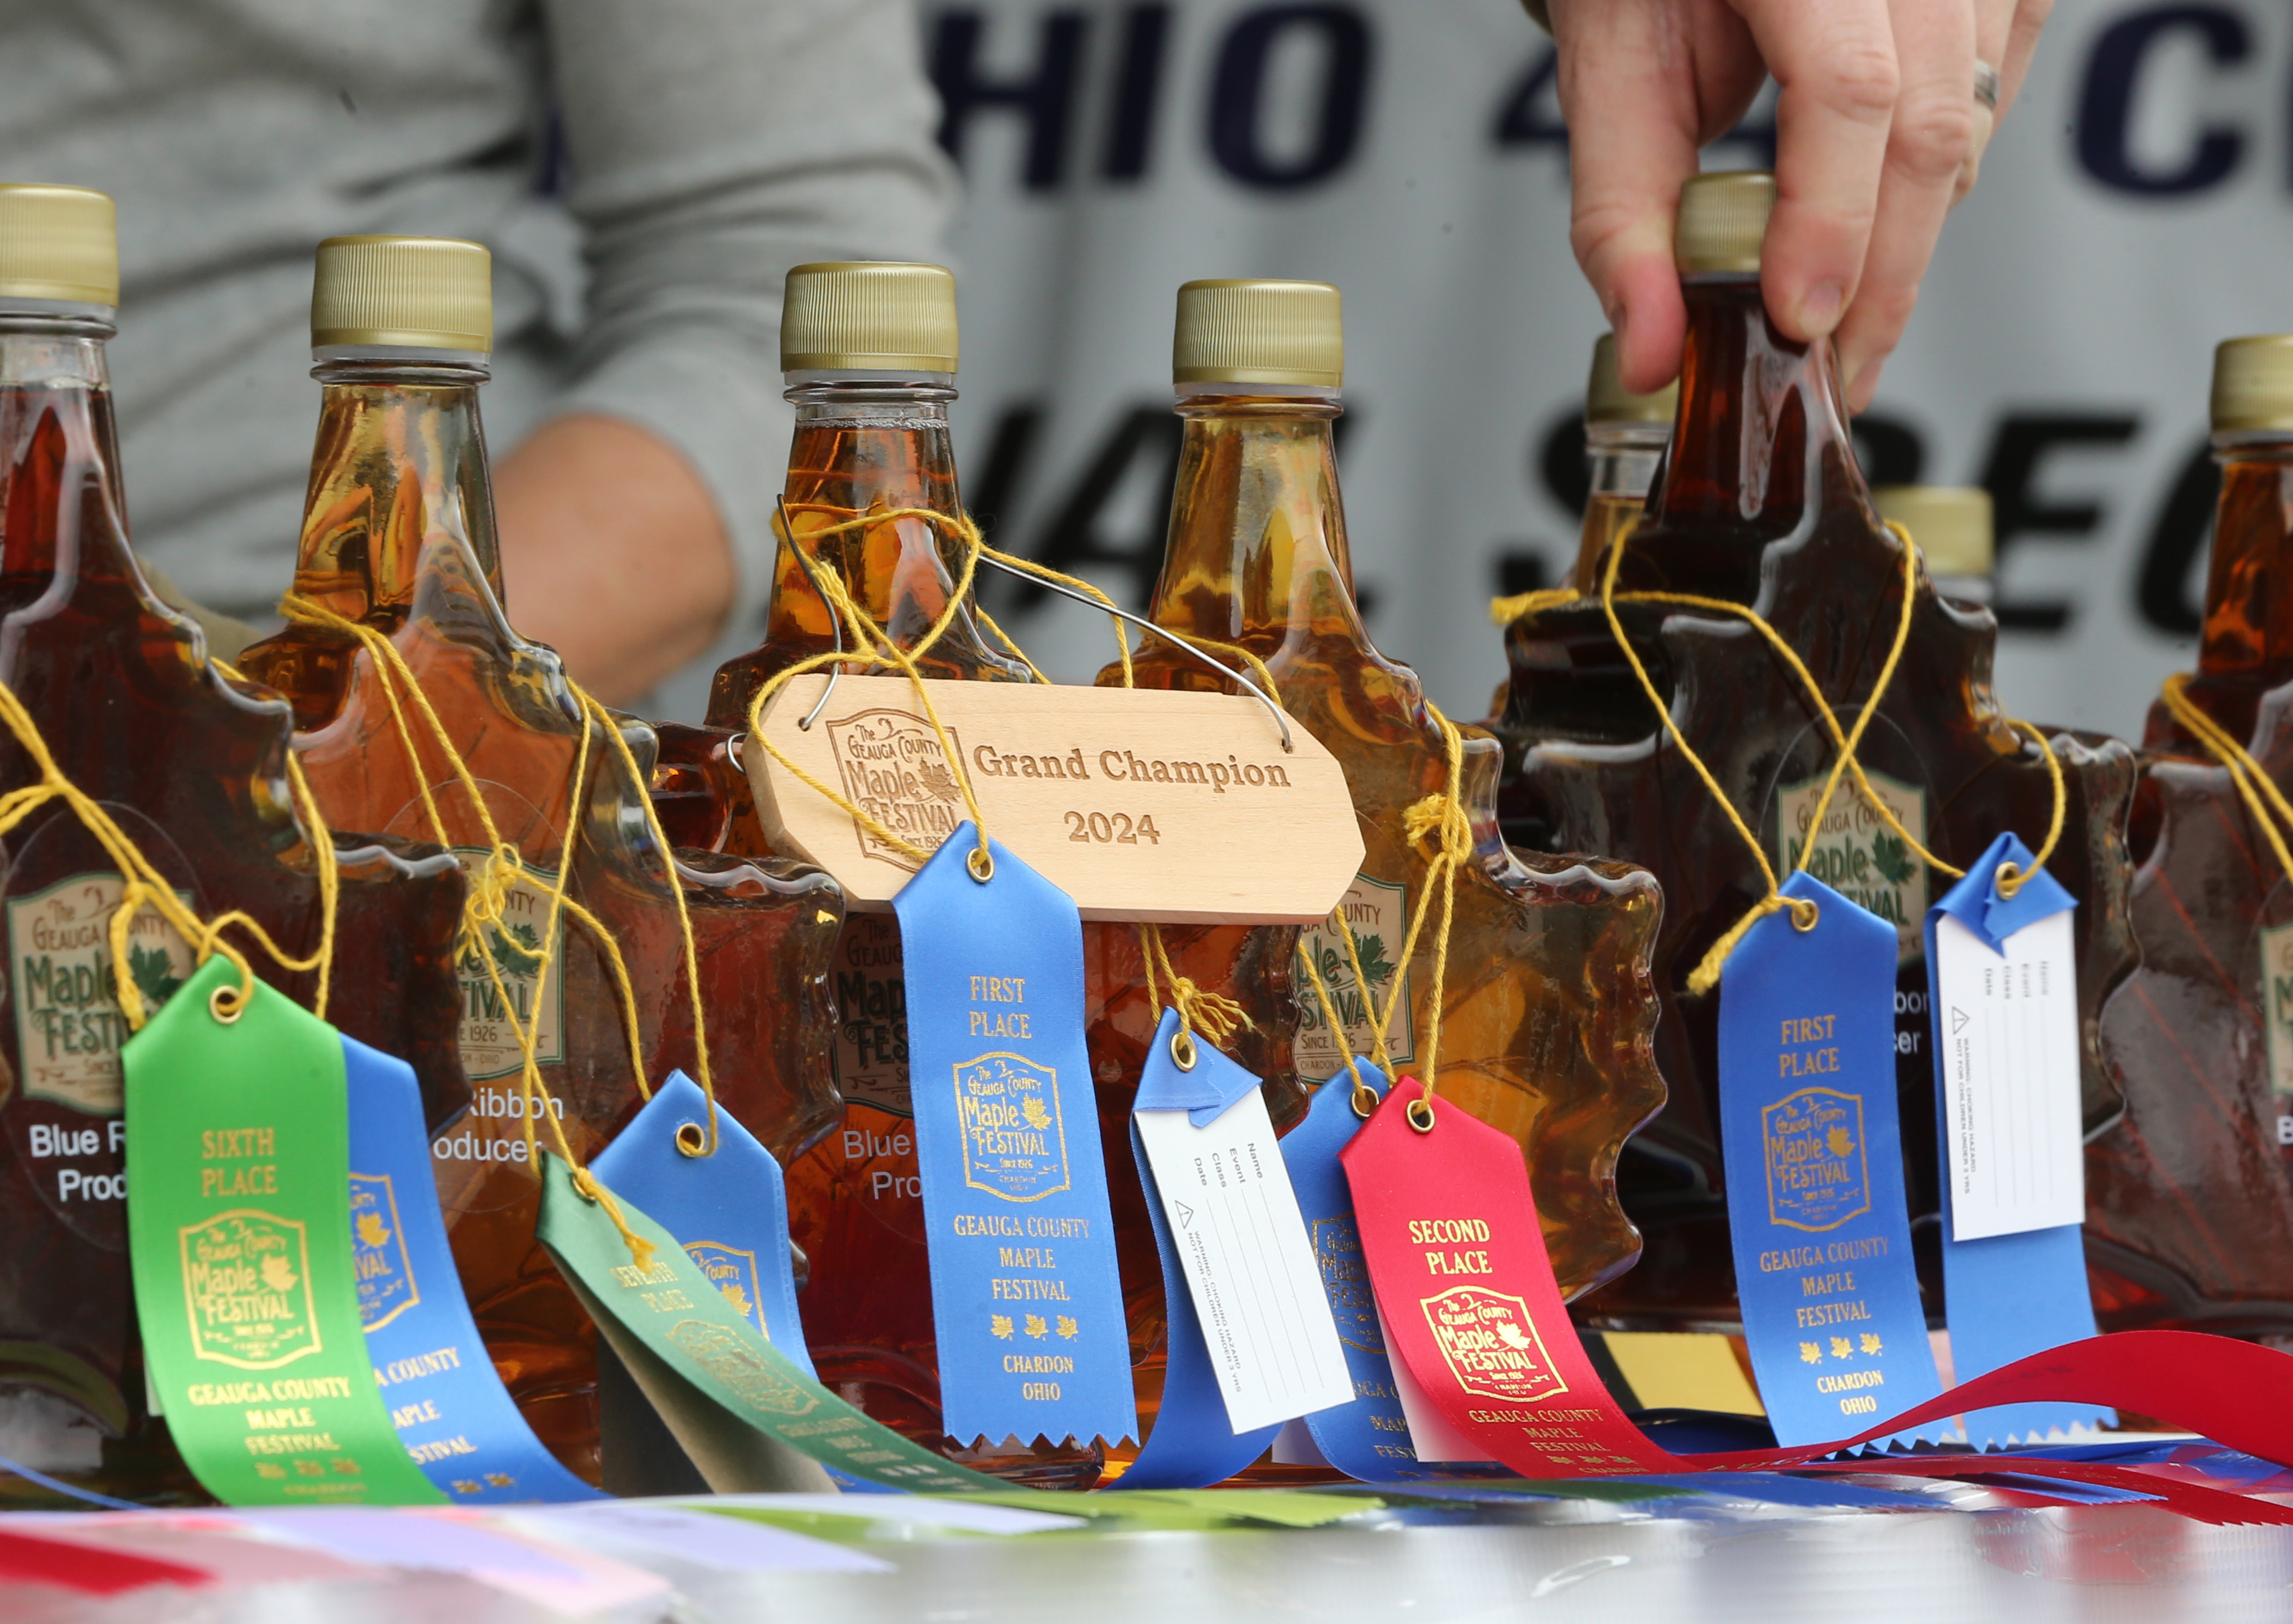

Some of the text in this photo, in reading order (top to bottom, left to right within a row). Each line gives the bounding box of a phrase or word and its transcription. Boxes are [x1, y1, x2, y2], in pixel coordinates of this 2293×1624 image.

[926, 3, 1377, 193] HIO
[855, 724, 876, 742] The
[848, 735, 942, 763] GEAUGA COUNTY
[845, 760, 923, 804] Maple
[974, 746, 1291, 794] Grand Champion
[1064, 811, 1160, 845] 2024
[33, 916, 101, 951] GEAUGA
[863, 918, 890, 942] The
[847, 935, 903, 967] GEAUG
[837, 970, 906, 1027] Map
[970, 976, 1025, 1003] FIRST
[470, 1026, 498, 1043] 1926
[969, 1011, 1032, 1039] PLACE
[1780, 1014, 1837, 1045] FIRST
[976, 1065, 992, 1081] The
[1300, 1058, 1336, 1070] CHARDON
[1779, 1047, 1840, 1078] PLACE
[968, 1075, 1042, 1098] GEAUGA COUNTY
[470, 1087, 564, 1120] ibbon
[963, 1096, 1020, 1132] Maple
[29, 1125, 100, 1158] Blue
[201, 1127, 275, 1160] SIXTH
[843, 1128, 911, 1159] Blue
[969, 1126, 1050, 1156] FESTIVAL
[1770, 1131, 1823, 1168] Maple
[1194, 1157, 1208, 1187] Date
[1212, 1152, 1228, 1189] Class
[1229, 1147, 1246, 1184] Event
[1247, 1142, 1264, 1180] Name
[58, 1168, 128, 1202] Prod
[201, 1164, 279, 1197] PLACE
[1775, 1161, 1851, 1193] FESTIVAL
[953, 1215, 1090, 1239] GEAUGA COUNTY
[1408, 1219, 1491, 1244] SECOND
[999, 1247, 1056, 1269] MAPLE
[1425, 1251, 1493, 1275] PLACE
[1760, 1237, 1889, 1273] GEAUGA COUNTY
[190, 1257, 258, 1298] Maple
[991, 1278, 1071, 1301] FESTIVAL
[1802, 1271, 1856, 1296] MAPLE
[196, 1292, 296, 1326] FESTIVAL
[1188, 1232, 1198, 1252] NOT
[1195, 1255, 1205, 1275] FOR
[1201, 1277, 1221, 1326] CHILDREN
[1218, 1328, 1232, 1363] UNDER
[1210, 1282, 1228, 1327] CHOKING
[1225, 1329, 1241, 1370] HAZARD
[1438, 1306, 1513, 1325] GEAUGA COUNTY
[1796, 1300, 1872, 1328] FESTIVAL
[1437, 1324, 1500, 1354] Maple
[387, 1347, 462, 1383] COUNTY
[1002, 1355, 1074, 1374] CHARDON
[1452, 1349, 1538, 1373] FESTIVAL
[187, 1381, 272, 1406] GEAUGA
[271, 1376, 352, 1401] COUNTY
[1022, 1382, 1061, 1401] OHIO
[1816, 1369, 1885, 1394] CHARDON
[245, 1407, 317, 1430] MAPLE
[392, 1399, 442, 1430] APLE
[1468, 1409, 1604, 1423] GEAUGA COUNTY
[1840, 1395, 1878, 1415] OHIO
[1369, 1415, 1407, 1433] MAP
[1522, 1427, 1584, 1438] MAPLE
[245, 1432, 342, 1456] FESTIVAL
[406, 1434, 478, 1465] STIVAL
[1373, 1445, 1417, 1459] FEST
[1530, 1441, 1611, 1452] FESTIVAL
